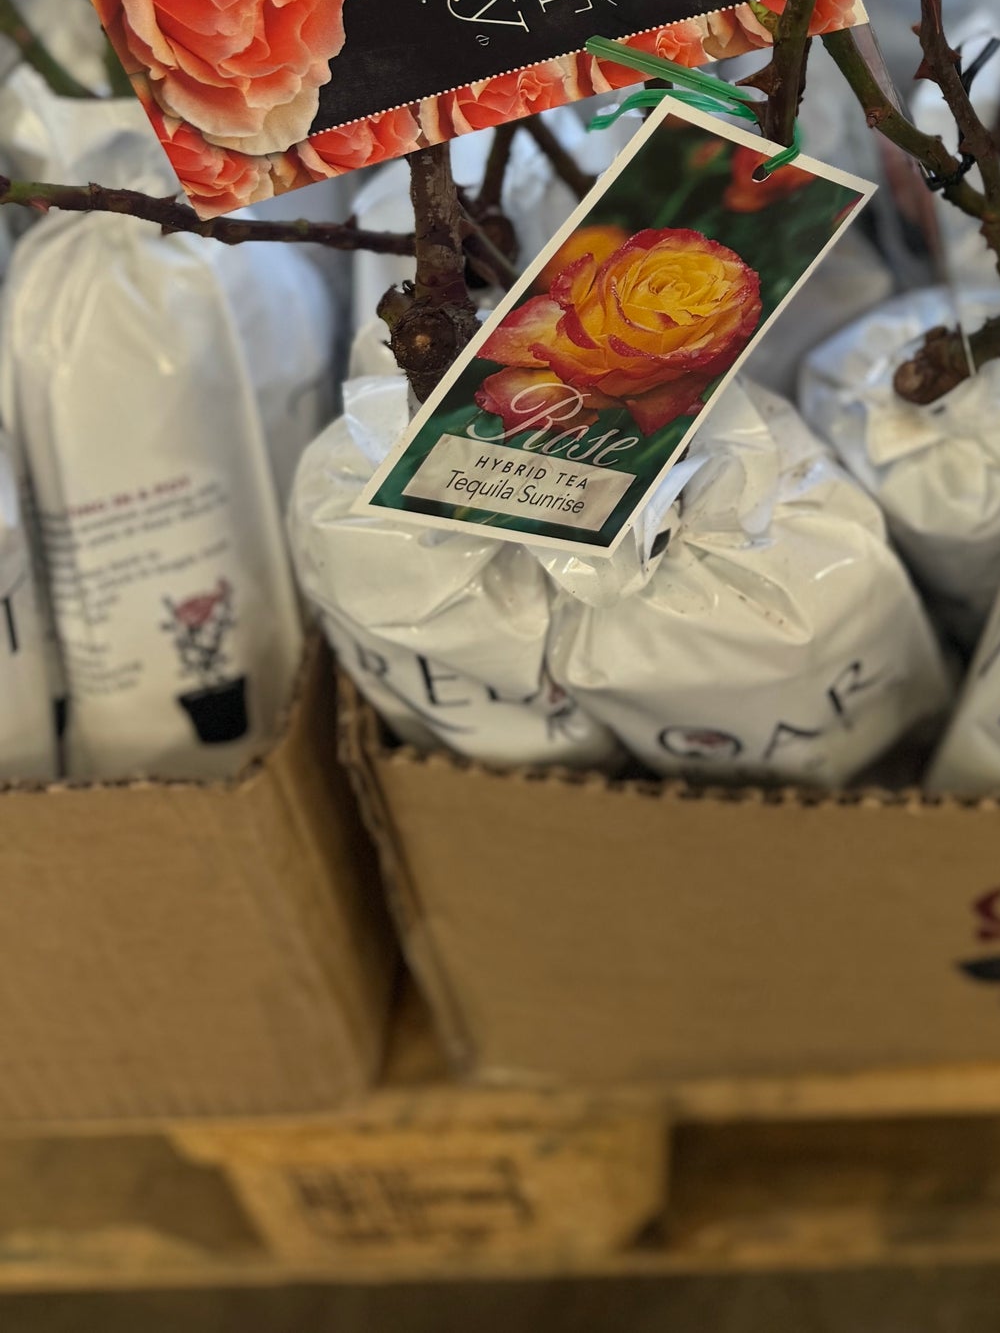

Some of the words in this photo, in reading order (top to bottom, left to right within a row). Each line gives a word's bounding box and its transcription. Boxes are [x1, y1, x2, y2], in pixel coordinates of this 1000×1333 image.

[466, 381, 640, 467] Rose
[444, 468, 516, 501] Tequila
[516, 483, 586, 515] Sunrise
[474, 454, 548, 481] HYBRID
[556, 471, 589, 490] TEA
